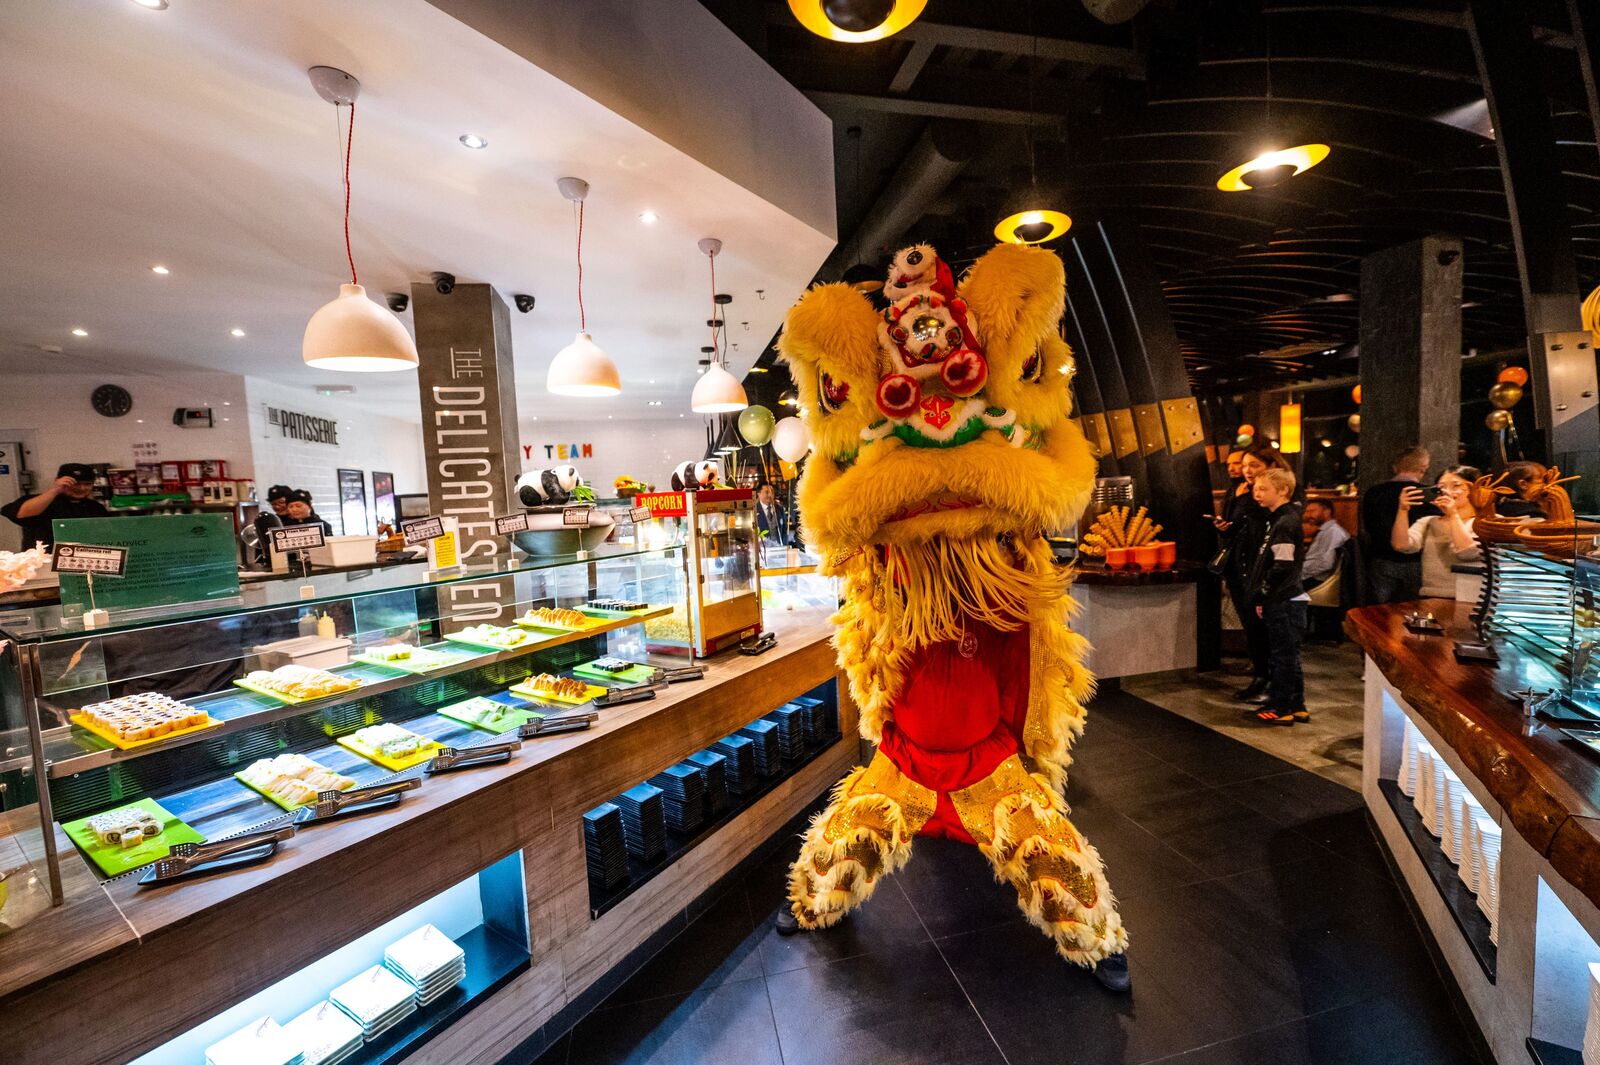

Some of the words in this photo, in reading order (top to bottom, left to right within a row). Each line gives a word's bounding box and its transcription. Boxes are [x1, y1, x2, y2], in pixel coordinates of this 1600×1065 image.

[454, 348, 483, 378] THE
[267, 407, 279, 423] THE
[280, 410, 339, 445] PATISSERIE
[544, 443, 592, 459] TEAM
[641, 495, 683, 511] POPCORN
